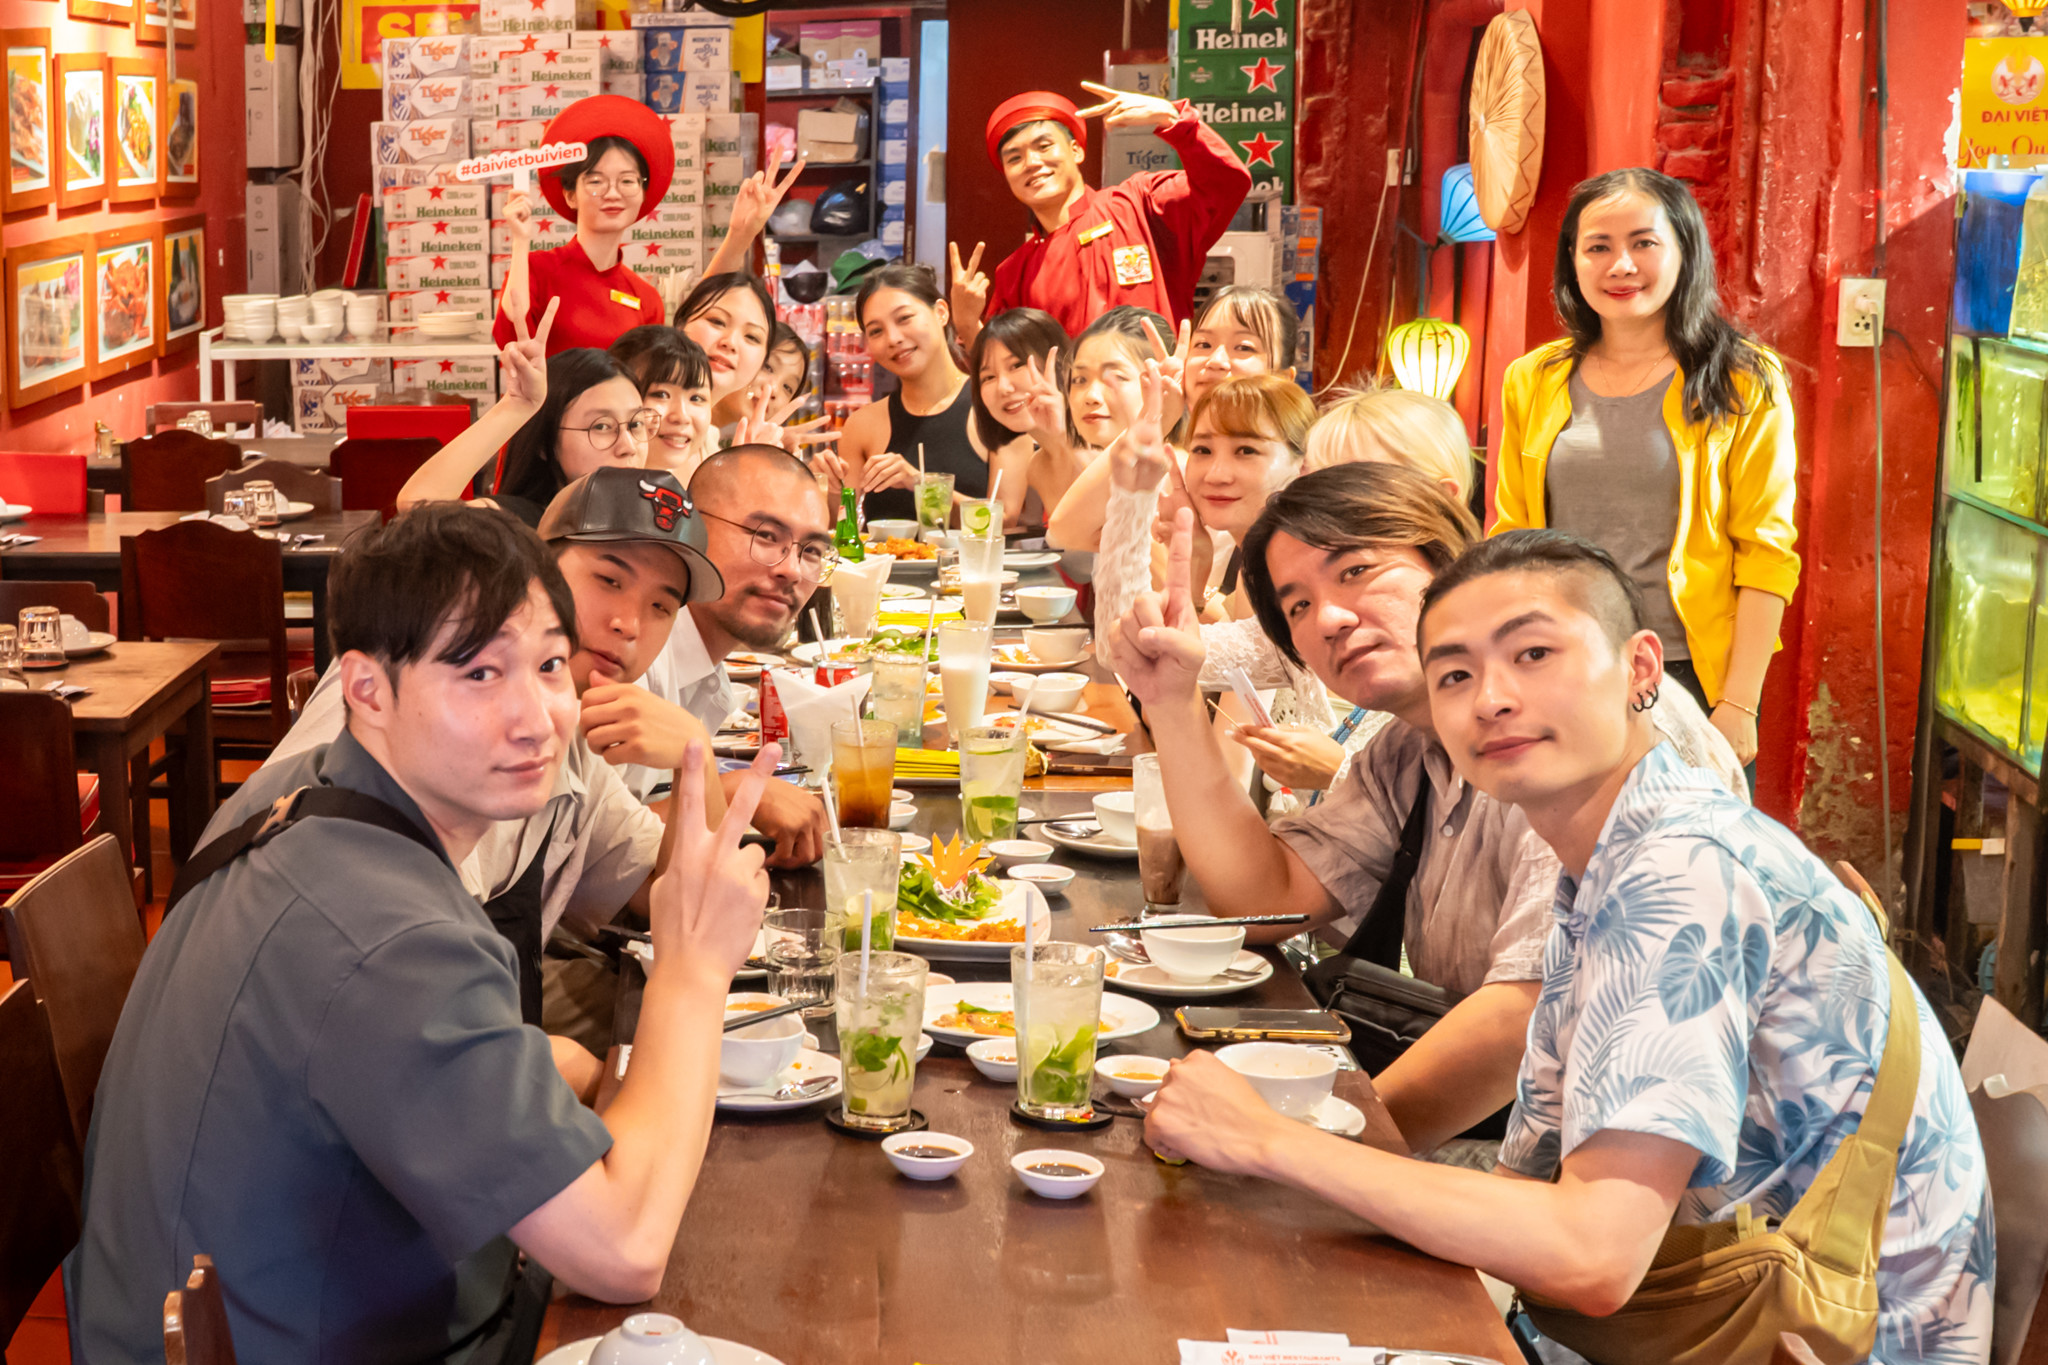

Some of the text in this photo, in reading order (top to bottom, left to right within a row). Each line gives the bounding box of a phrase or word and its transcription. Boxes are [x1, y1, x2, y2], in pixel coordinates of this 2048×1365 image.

[502, 17, 574, 32] Heineken
[419, 42, 456, 61] Tiger
[531, 70, 592, 81] Heineken
[420, 83, 457, 103] Tiger
[408, 125, 447, 146] Tiger
[461, 145, 583, 176] #daivietbuivien
[1126, 149, 1168, 170] Tiger
[416, 206, 477, 218] Heineken
[631, 229, 694, 240] Heineken
[421, 241, 482, 253] Heineken
[420, 276, 480, 288] Heineken
[426, 379, 487, 390] Heineken
